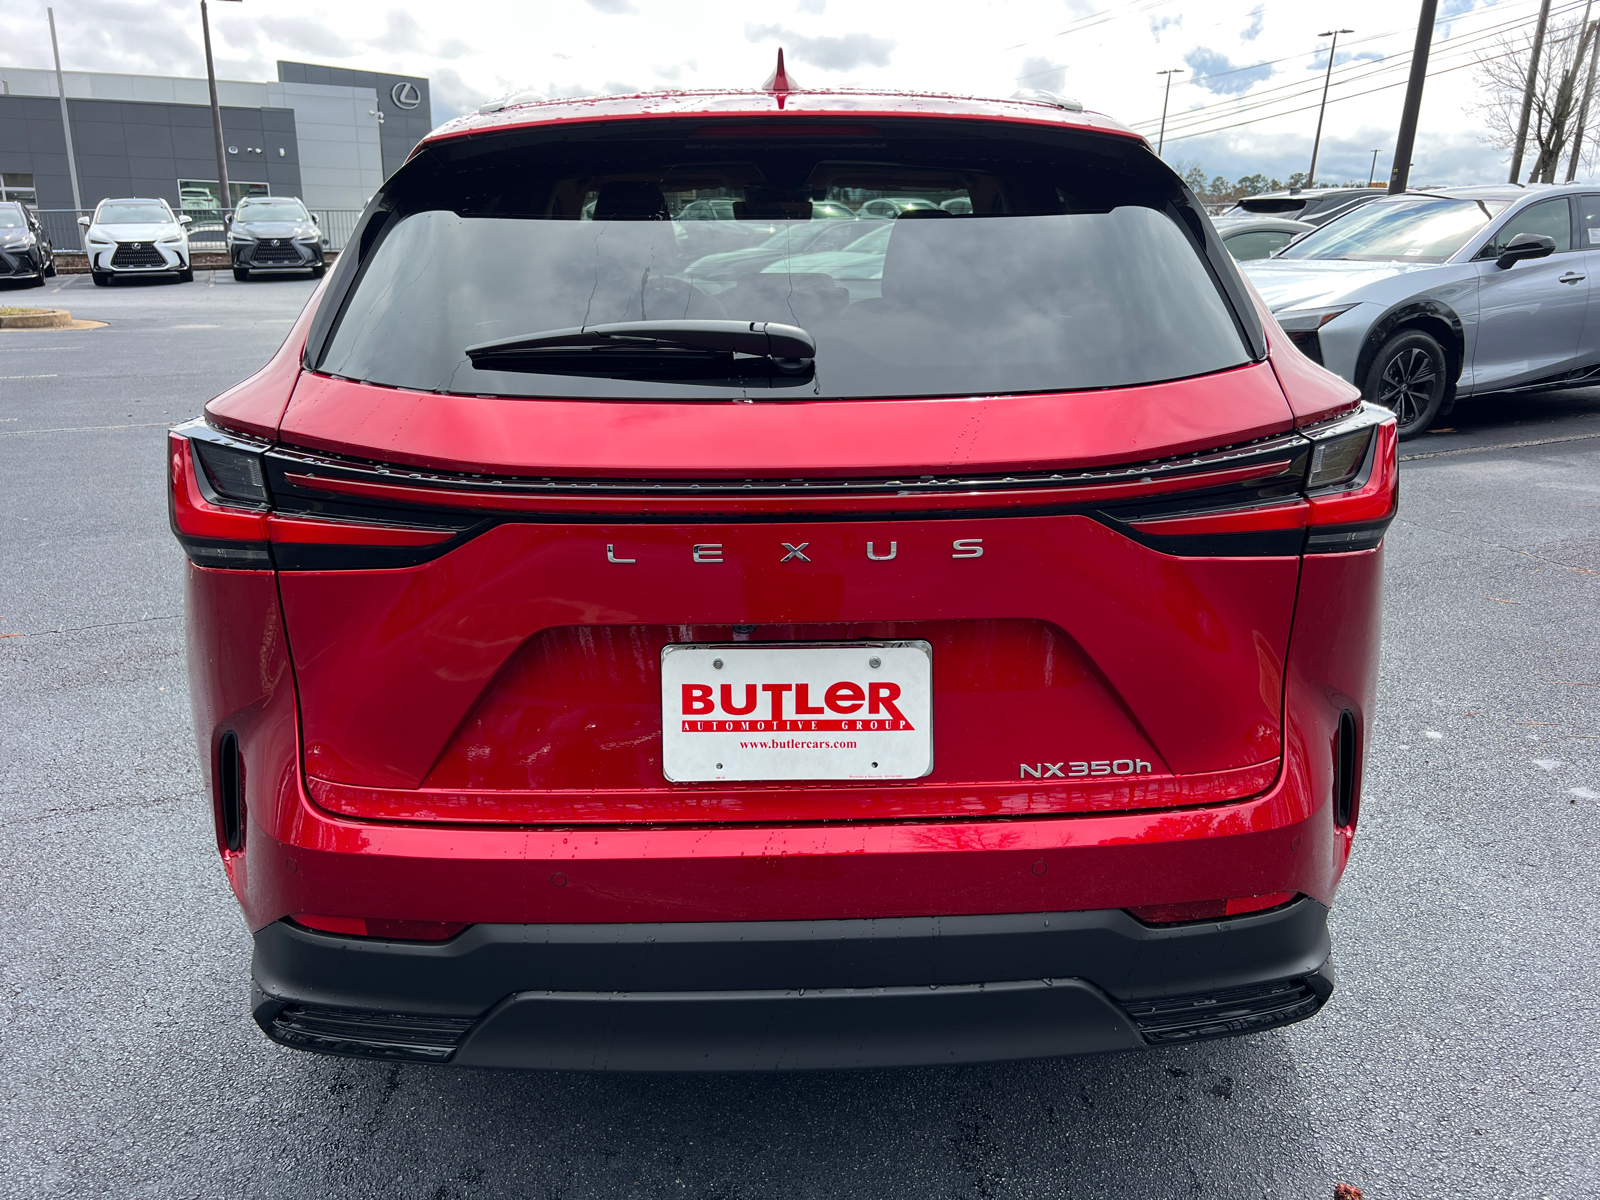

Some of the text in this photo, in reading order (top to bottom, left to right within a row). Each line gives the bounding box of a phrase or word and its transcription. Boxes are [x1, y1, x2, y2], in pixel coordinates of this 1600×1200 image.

[606, 538, 984, 564] LEXUS
[682, 720, 907, 732] AUTOMOTIVE GROUP
[739, 738, 858, 750] www.butlercars.com
[1019, 758, 1152, 779] NX350h
